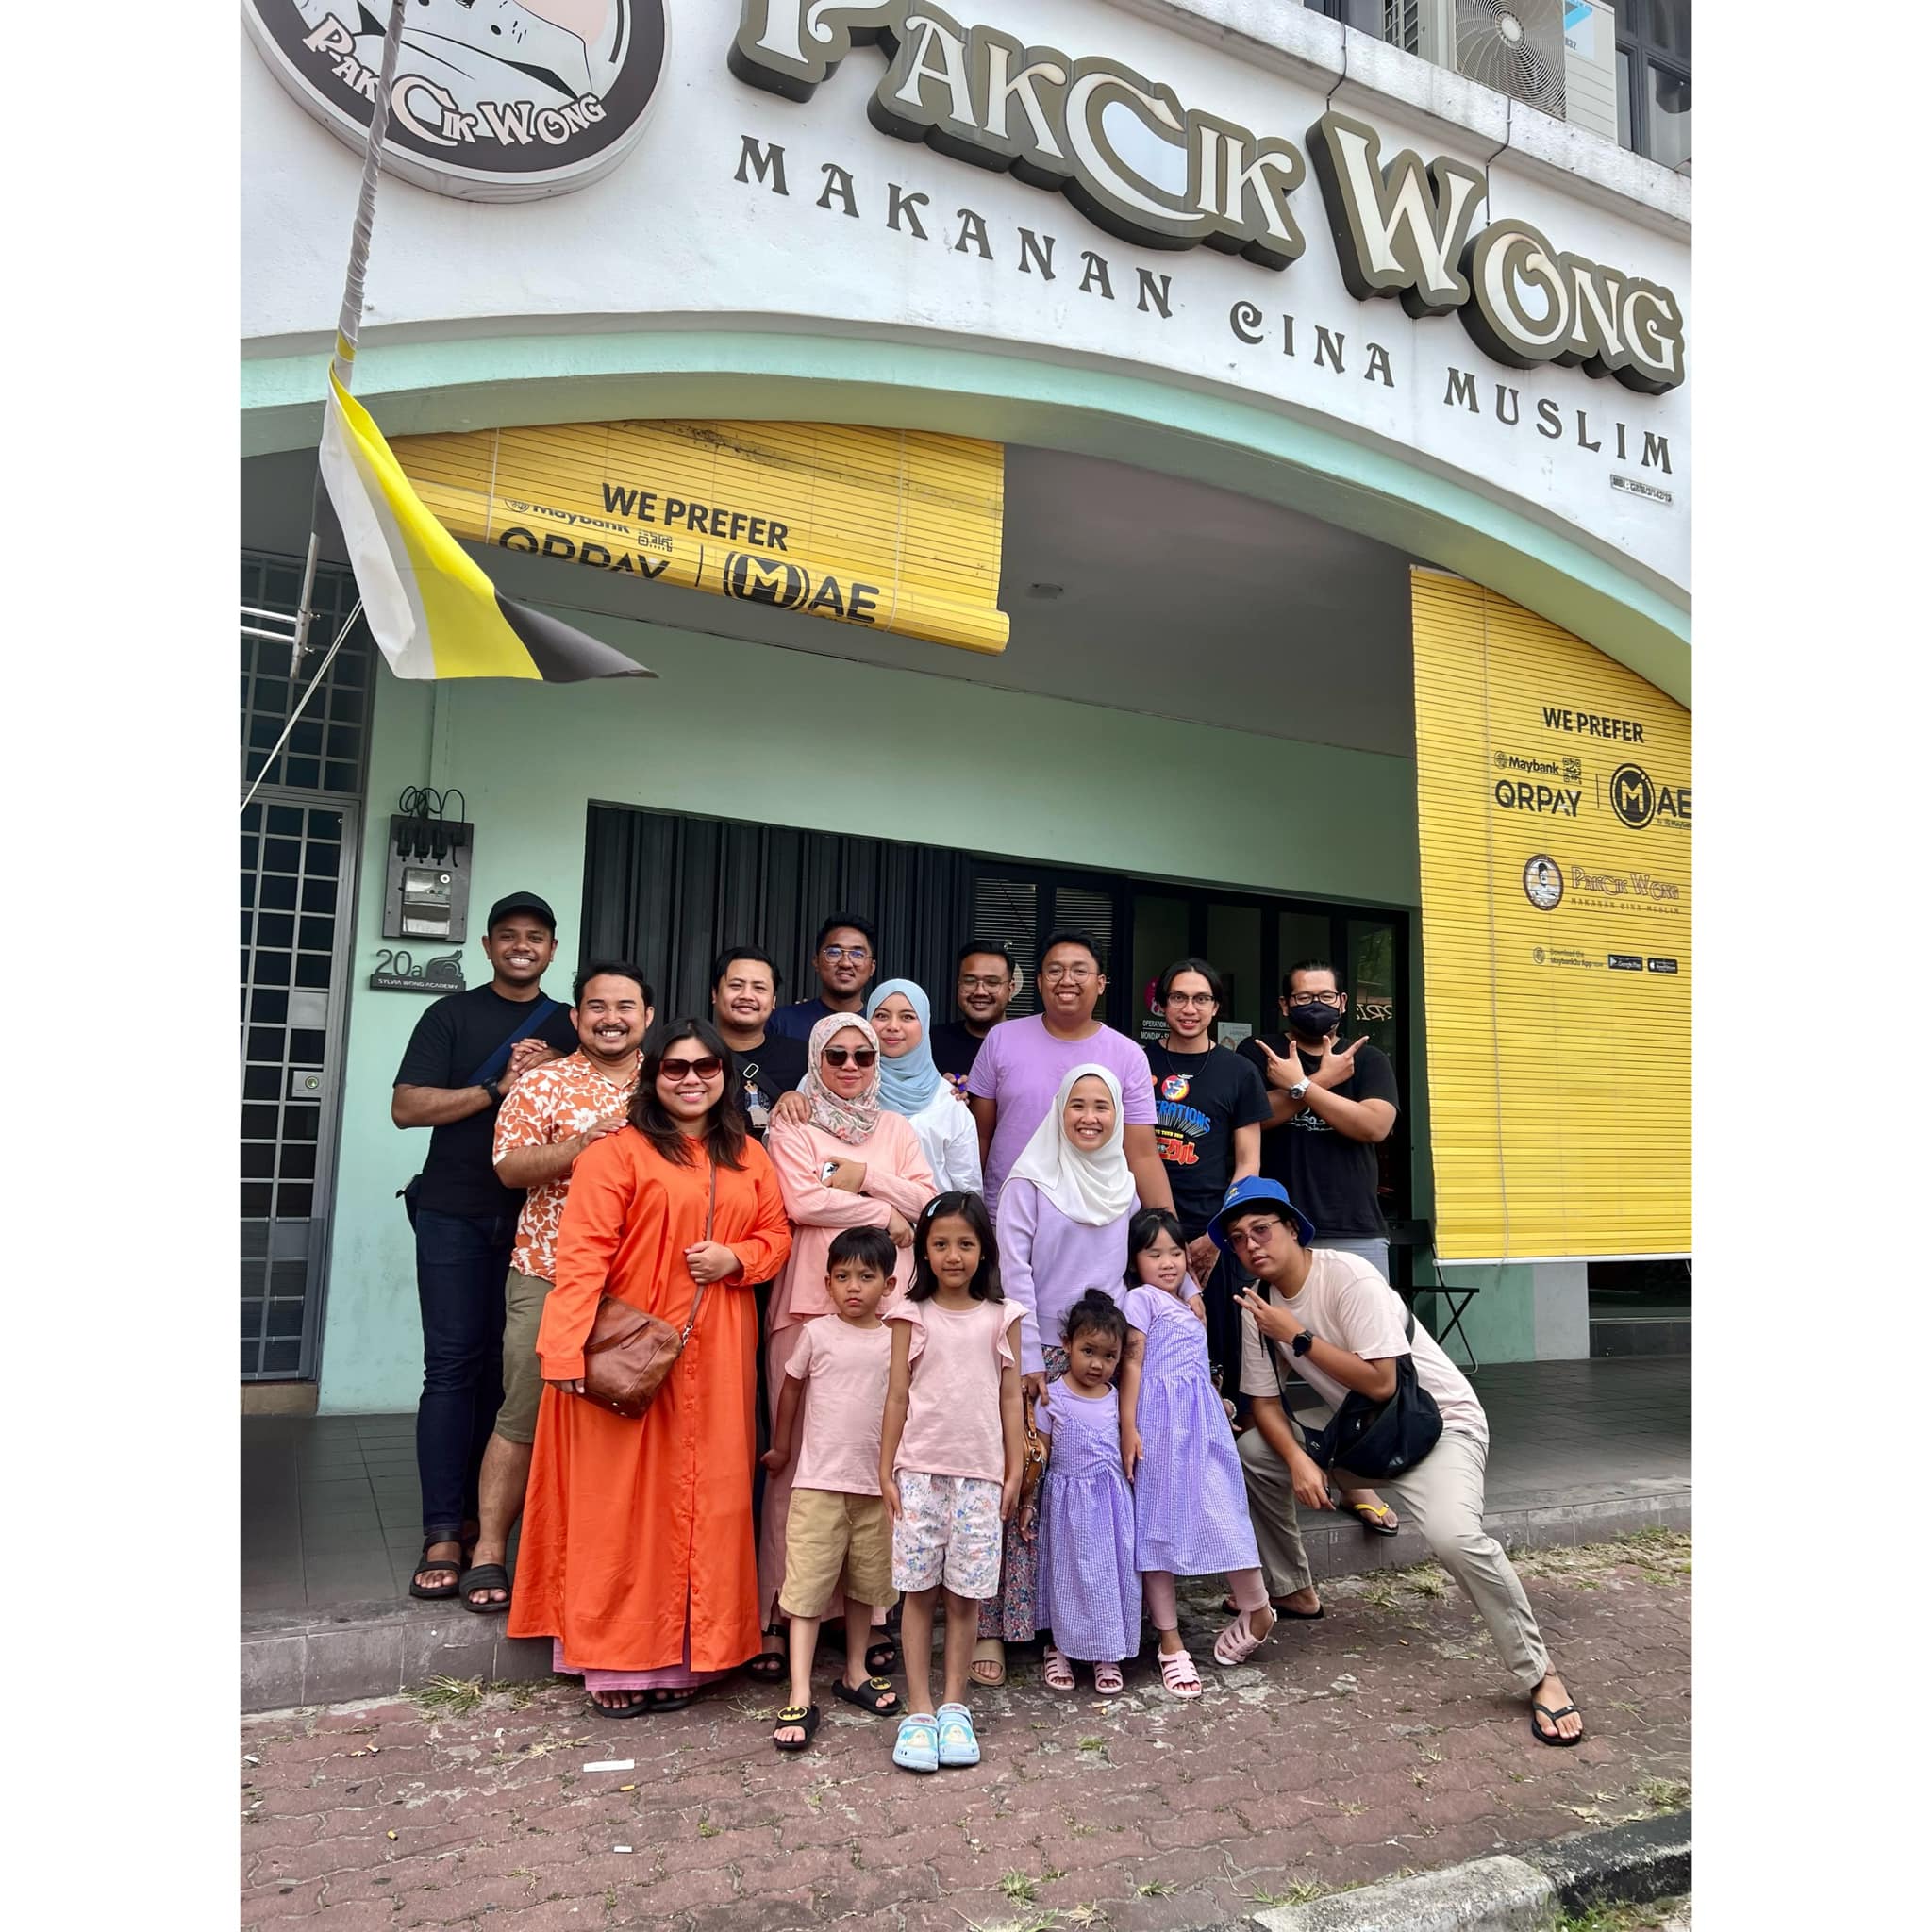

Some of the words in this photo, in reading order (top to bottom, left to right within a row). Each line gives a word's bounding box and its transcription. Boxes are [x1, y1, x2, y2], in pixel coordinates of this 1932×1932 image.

[478, 94, 608, 146] WONG
[1334, 126, 1676, 373] WONG
[734, 135, 1173, 319] MAKANAN
[1229, 300, 1395, 388] CINA
[1444, 367, 1674, 474] MUSLIM
[602, 482, 658, 523] WE
[663, 497, 789, 552] PREFER
[1542, 707, 1574, 732] WE
[1576, 712, 1645, 743] PREFER
[1508, 756, 1559, 775] Maybank
[1494, 779, 1582, 818] QRPAY
[375, 948, 423, 977] 20a
[1155, 1100, 1211, 1133] ERATIONS
